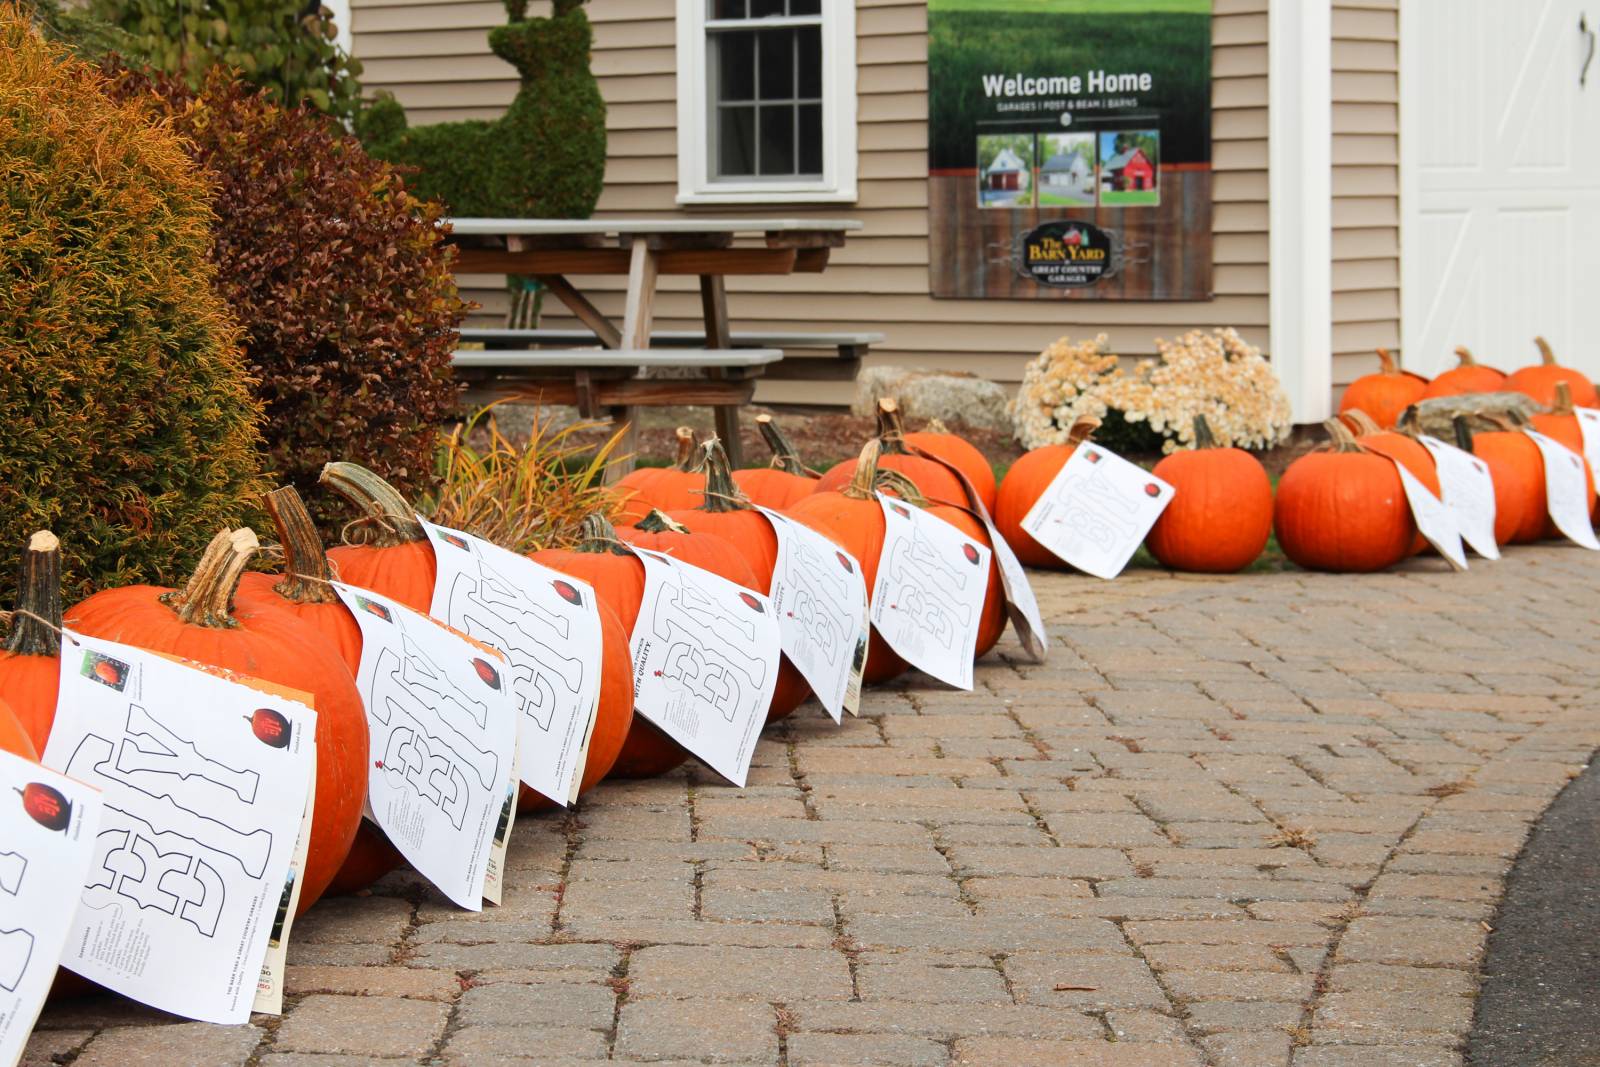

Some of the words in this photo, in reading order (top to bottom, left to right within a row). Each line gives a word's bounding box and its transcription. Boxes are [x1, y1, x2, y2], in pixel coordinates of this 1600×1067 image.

[982, 73, 1082, 97] Welcome
[1088, 70, 1152, 93] Home
[996, 102, 1036, 112] GARAGES
[1043, 101, 1066, 110] POST
[1076, 99, 1099, 110] BEAM
[1108, 98, 1138, 109] BARNS
[1042, 238, 1061, 249] The
[634, 677, 642, 698] WITH
[639, 641, 652, 676] QUALITY.
